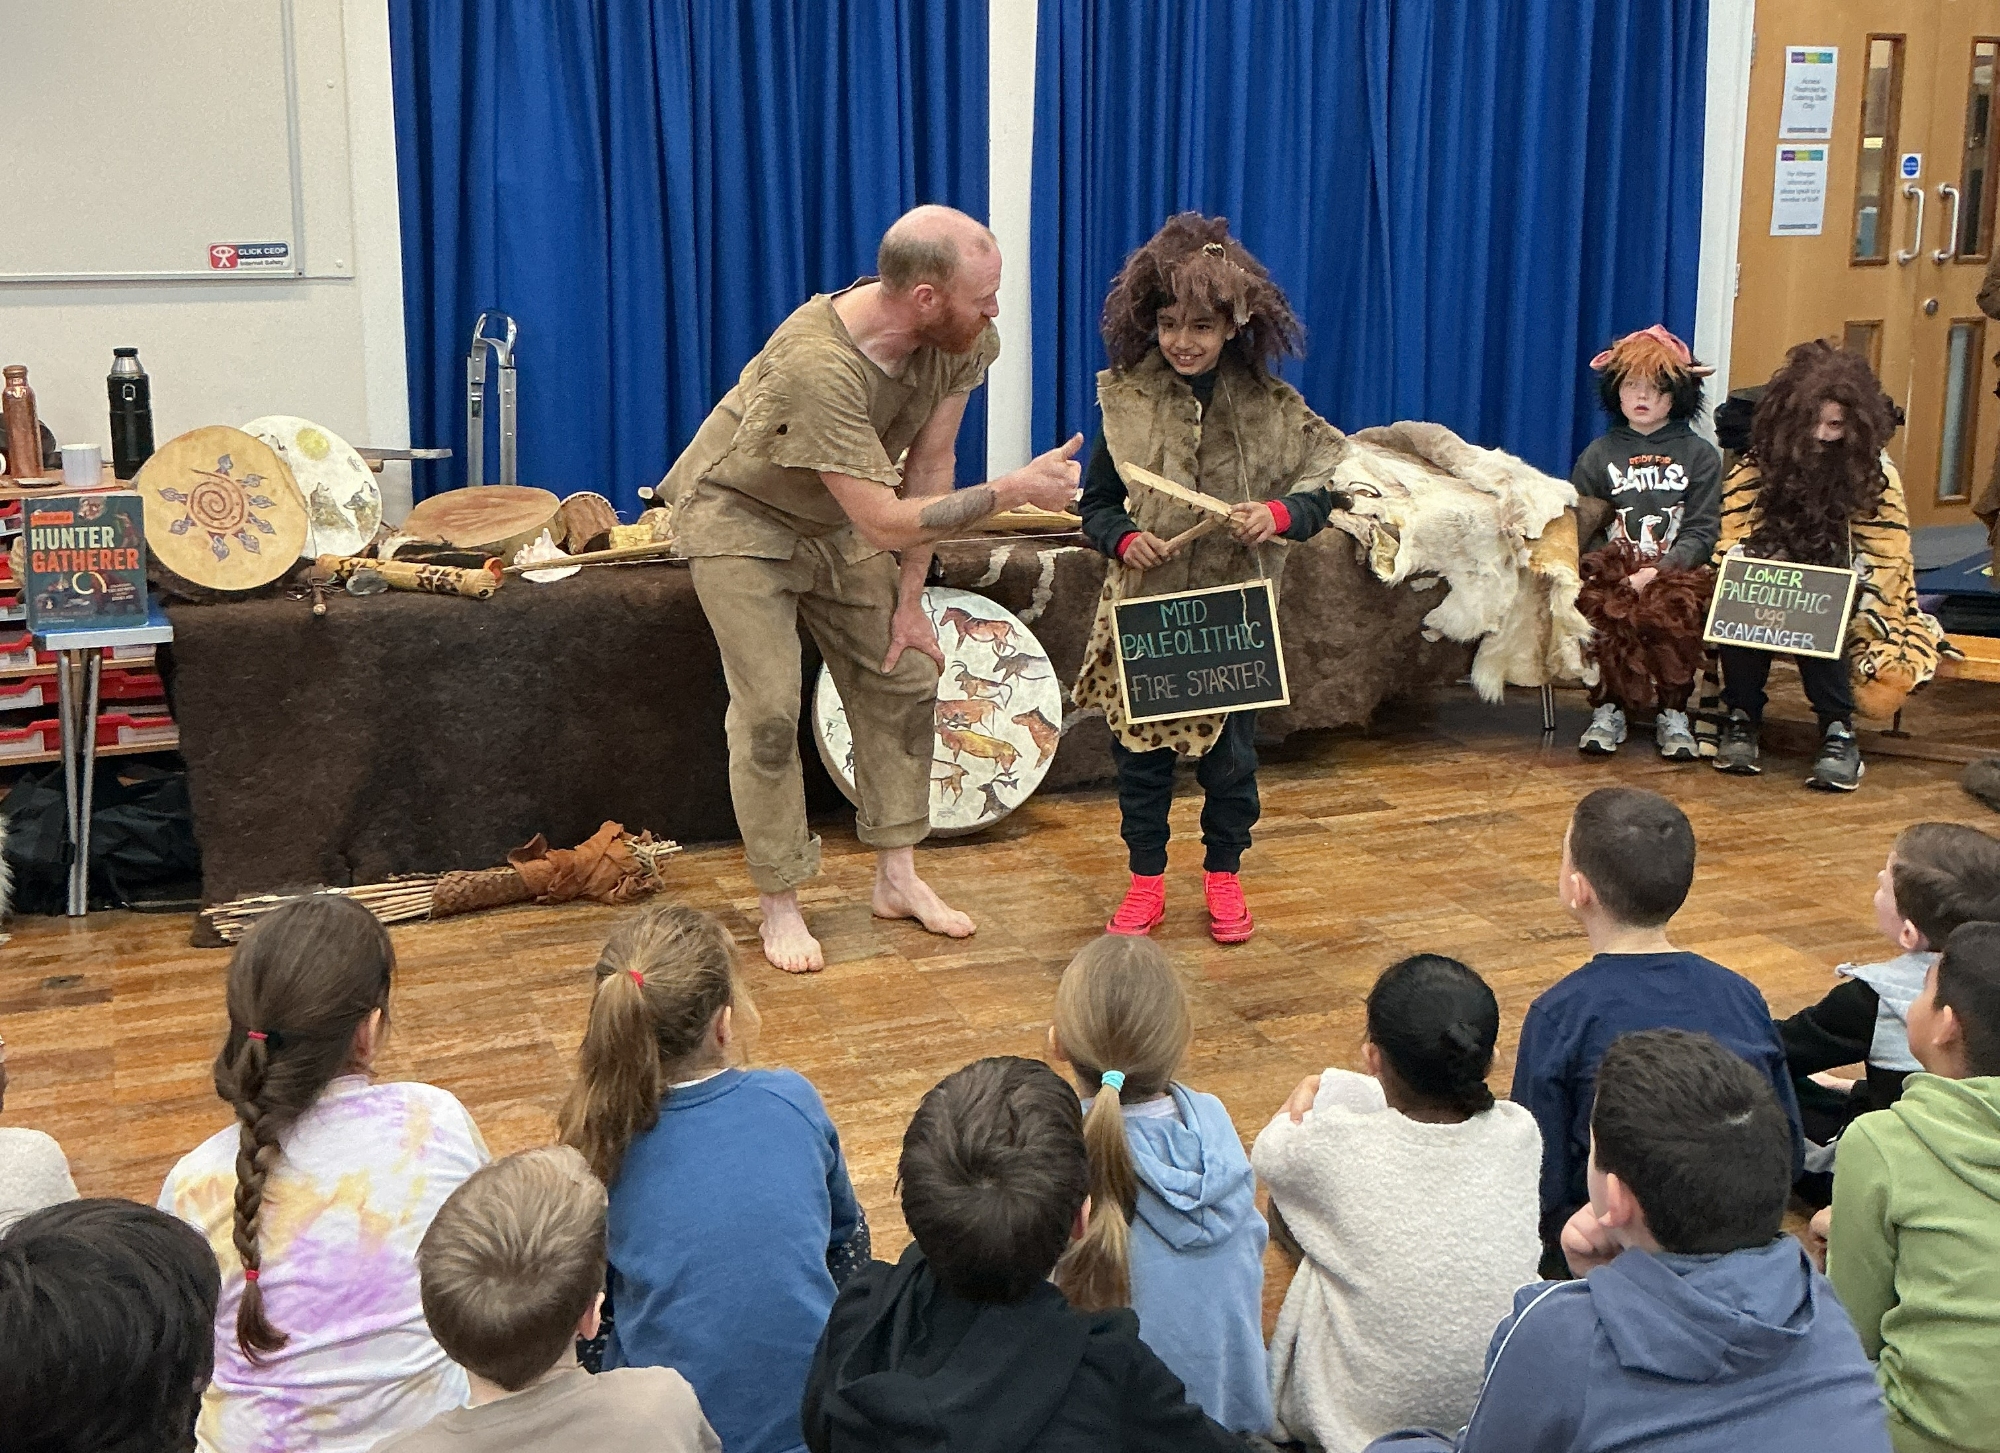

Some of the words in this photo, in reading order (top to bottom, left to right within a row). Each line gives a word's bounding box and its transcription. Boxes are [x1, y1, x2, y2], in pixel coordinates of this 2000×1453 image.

[238, 248, 263, 256] CLICK
[264, 247, 287, 255] CEOP
[1607, 462, 1689, 495] BATTLE
[31, 526, 115, 550] HUNTER
[32, 548, 139, 573] GATHERER
[1720, 579, 1832, 615] PALEOLITHIC
[1160, 600, 1207, 628] MID
[1121, 621, 1265, 659] PALEOLITHIC
[1712, 620, 1815, 650] SCAVENGER
[1131, 673, 1179, 702] FIRE
[1187, 660, 1272, 697] STARTER
